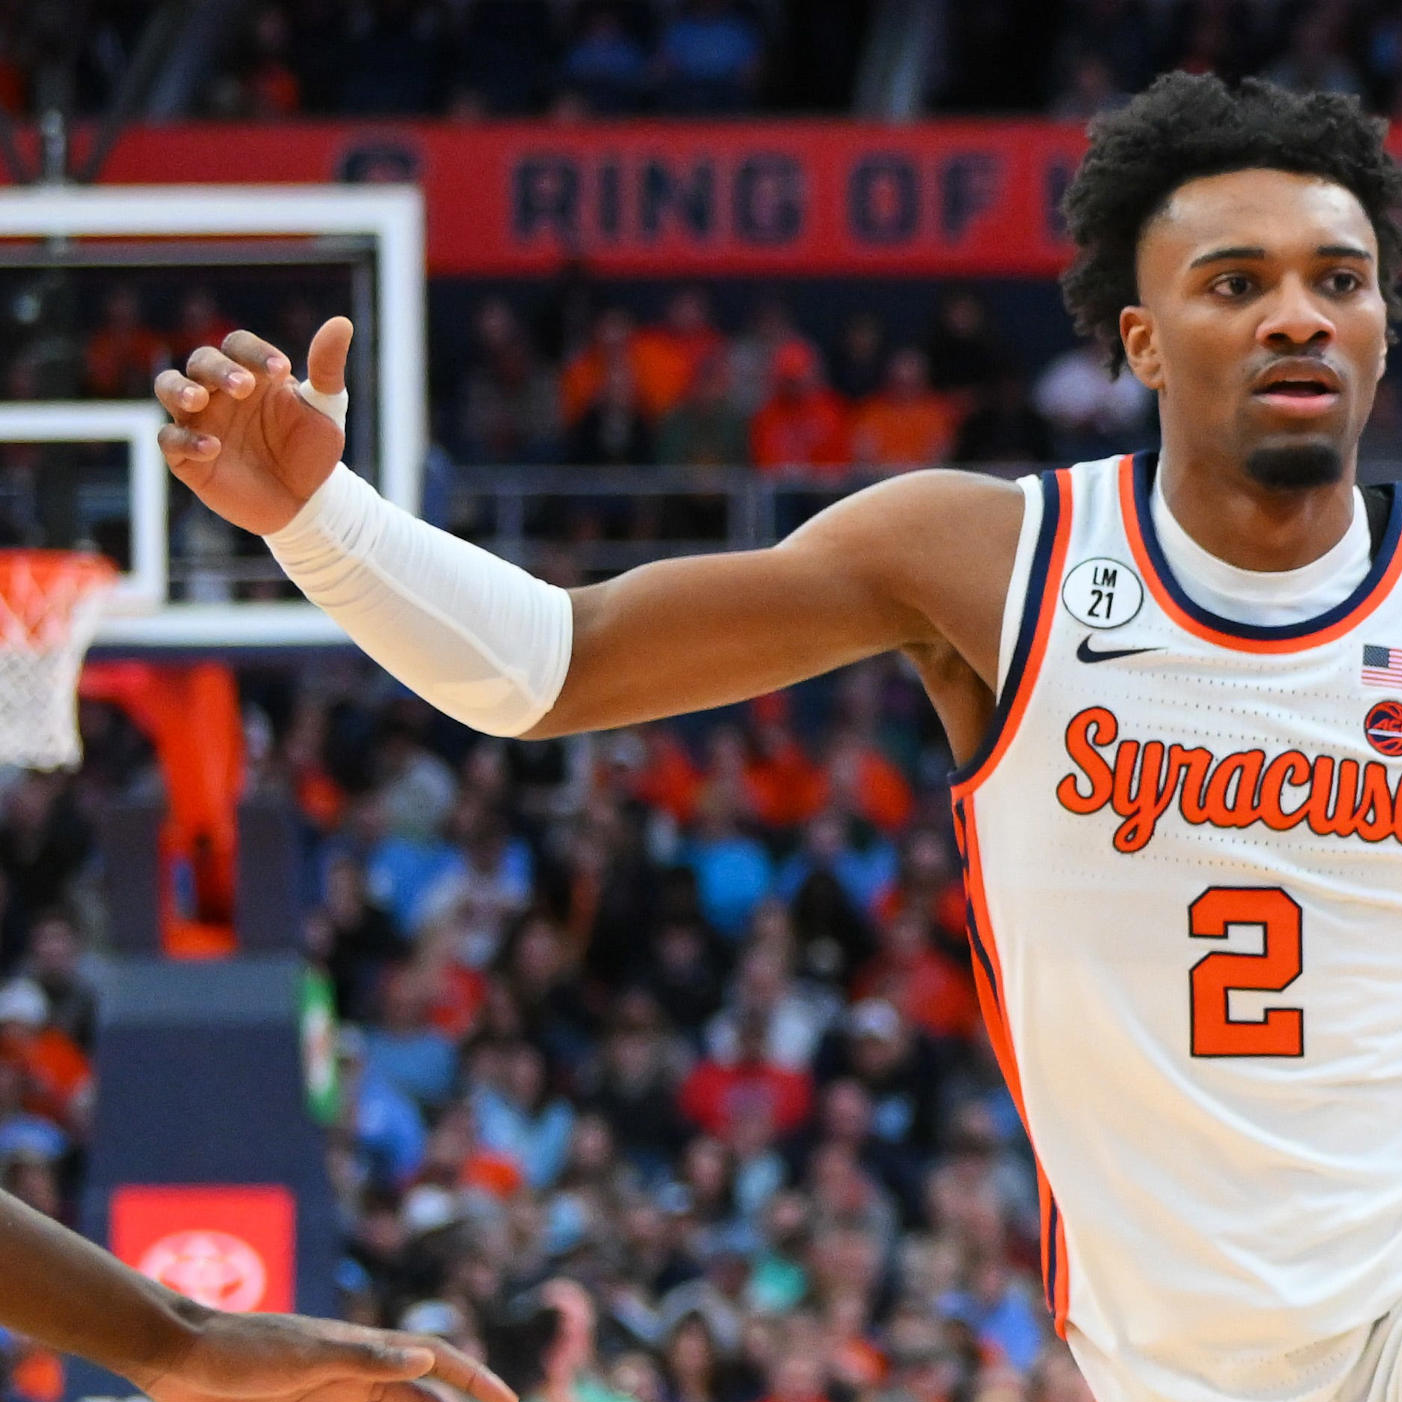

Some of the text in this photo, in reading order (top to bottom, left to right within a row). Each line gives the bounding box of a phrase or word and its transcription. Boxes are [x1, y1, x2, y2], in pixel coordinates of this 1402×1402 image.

[509, 151, 808, 247] RING
[847, 151, 1004, 246] OF
[1087, 589, 1114, 619] 21
[1092, 566, 1117, 588] LM
[1188, 886, 1304, 1057] 2
